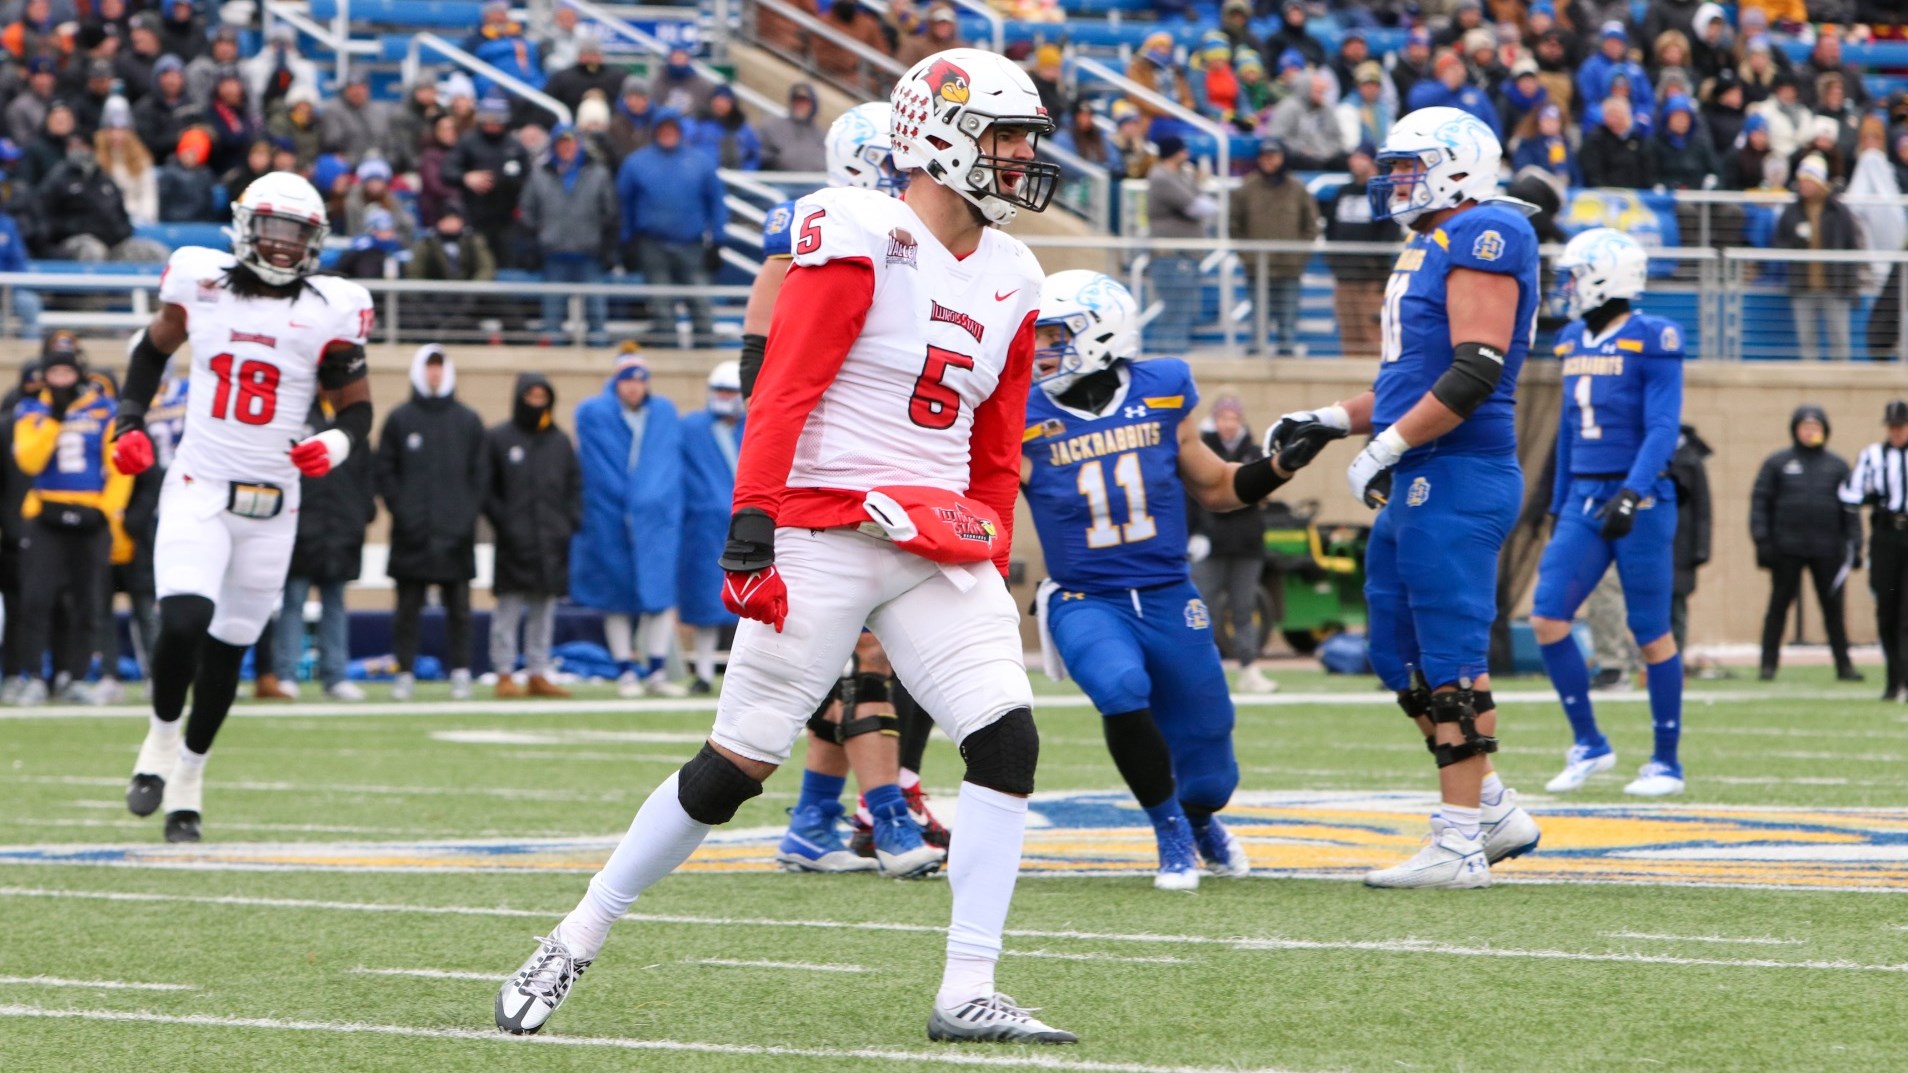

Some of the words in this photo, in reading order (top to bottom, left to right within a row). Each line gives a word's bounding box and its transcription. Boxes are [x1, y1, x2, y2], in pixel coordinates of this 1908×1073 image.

[797, 209, 825, 255] 5
[209, 352, 281, 426] 18
[1574, 375, 1602, 439] 1
[1049, 421, 1162, 467] JACKRABBITS
[1077, 452, 1157, 549] 11
